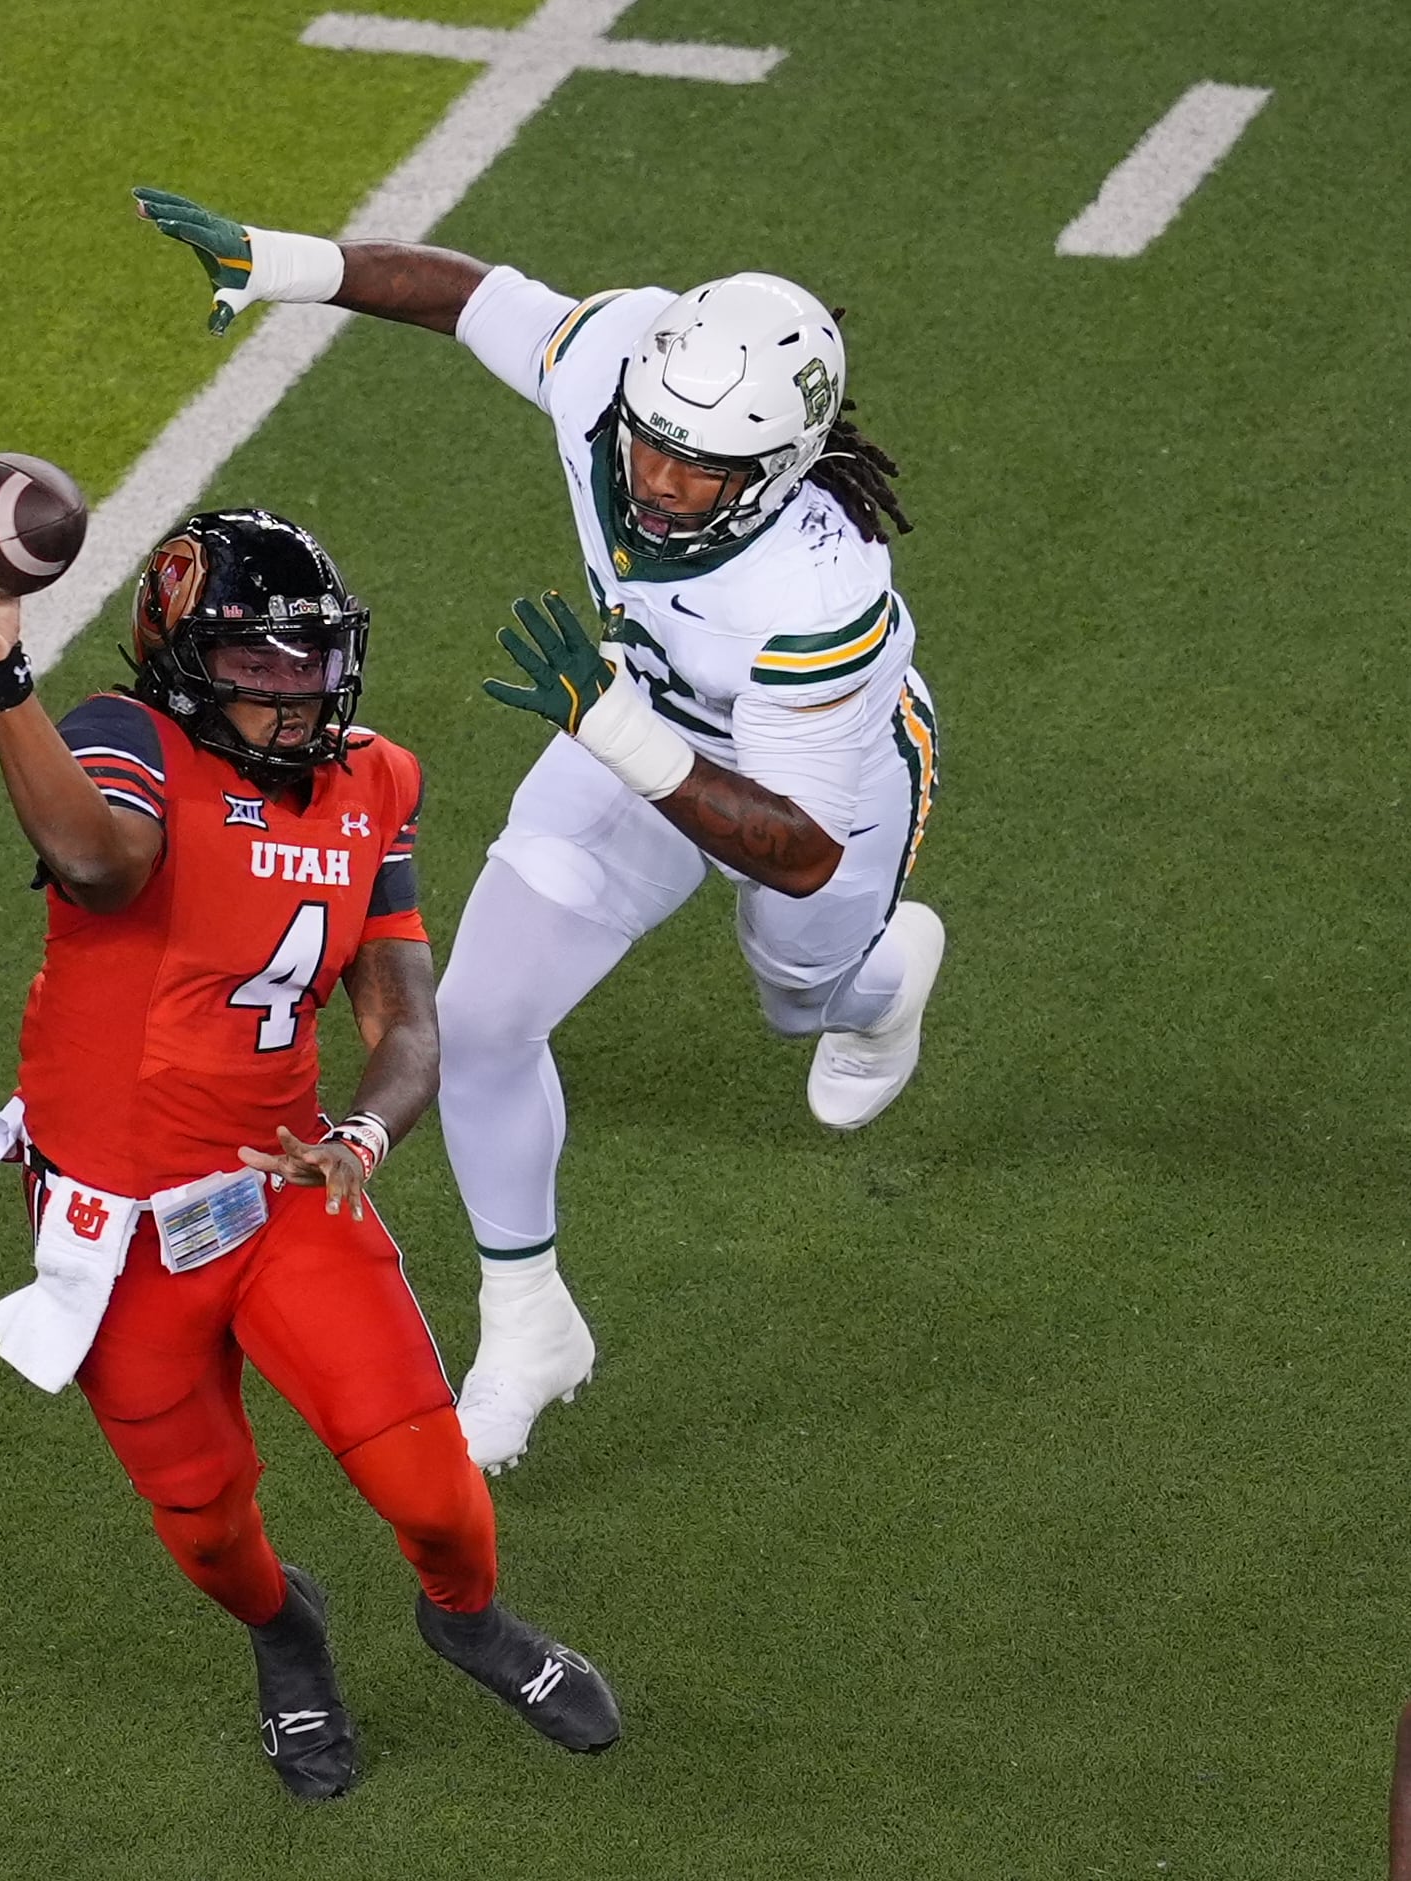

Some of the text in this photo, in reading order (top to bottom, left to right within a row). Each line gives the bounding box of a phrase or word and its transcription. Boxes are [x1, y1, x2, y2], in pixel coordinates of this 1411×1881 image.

[650, 411, 689, 443] BAYLOR
[222, 791, 269, 831] XII
[251, 840, 350, 886] UTAH
[225, 900, 328, 1053] 4
